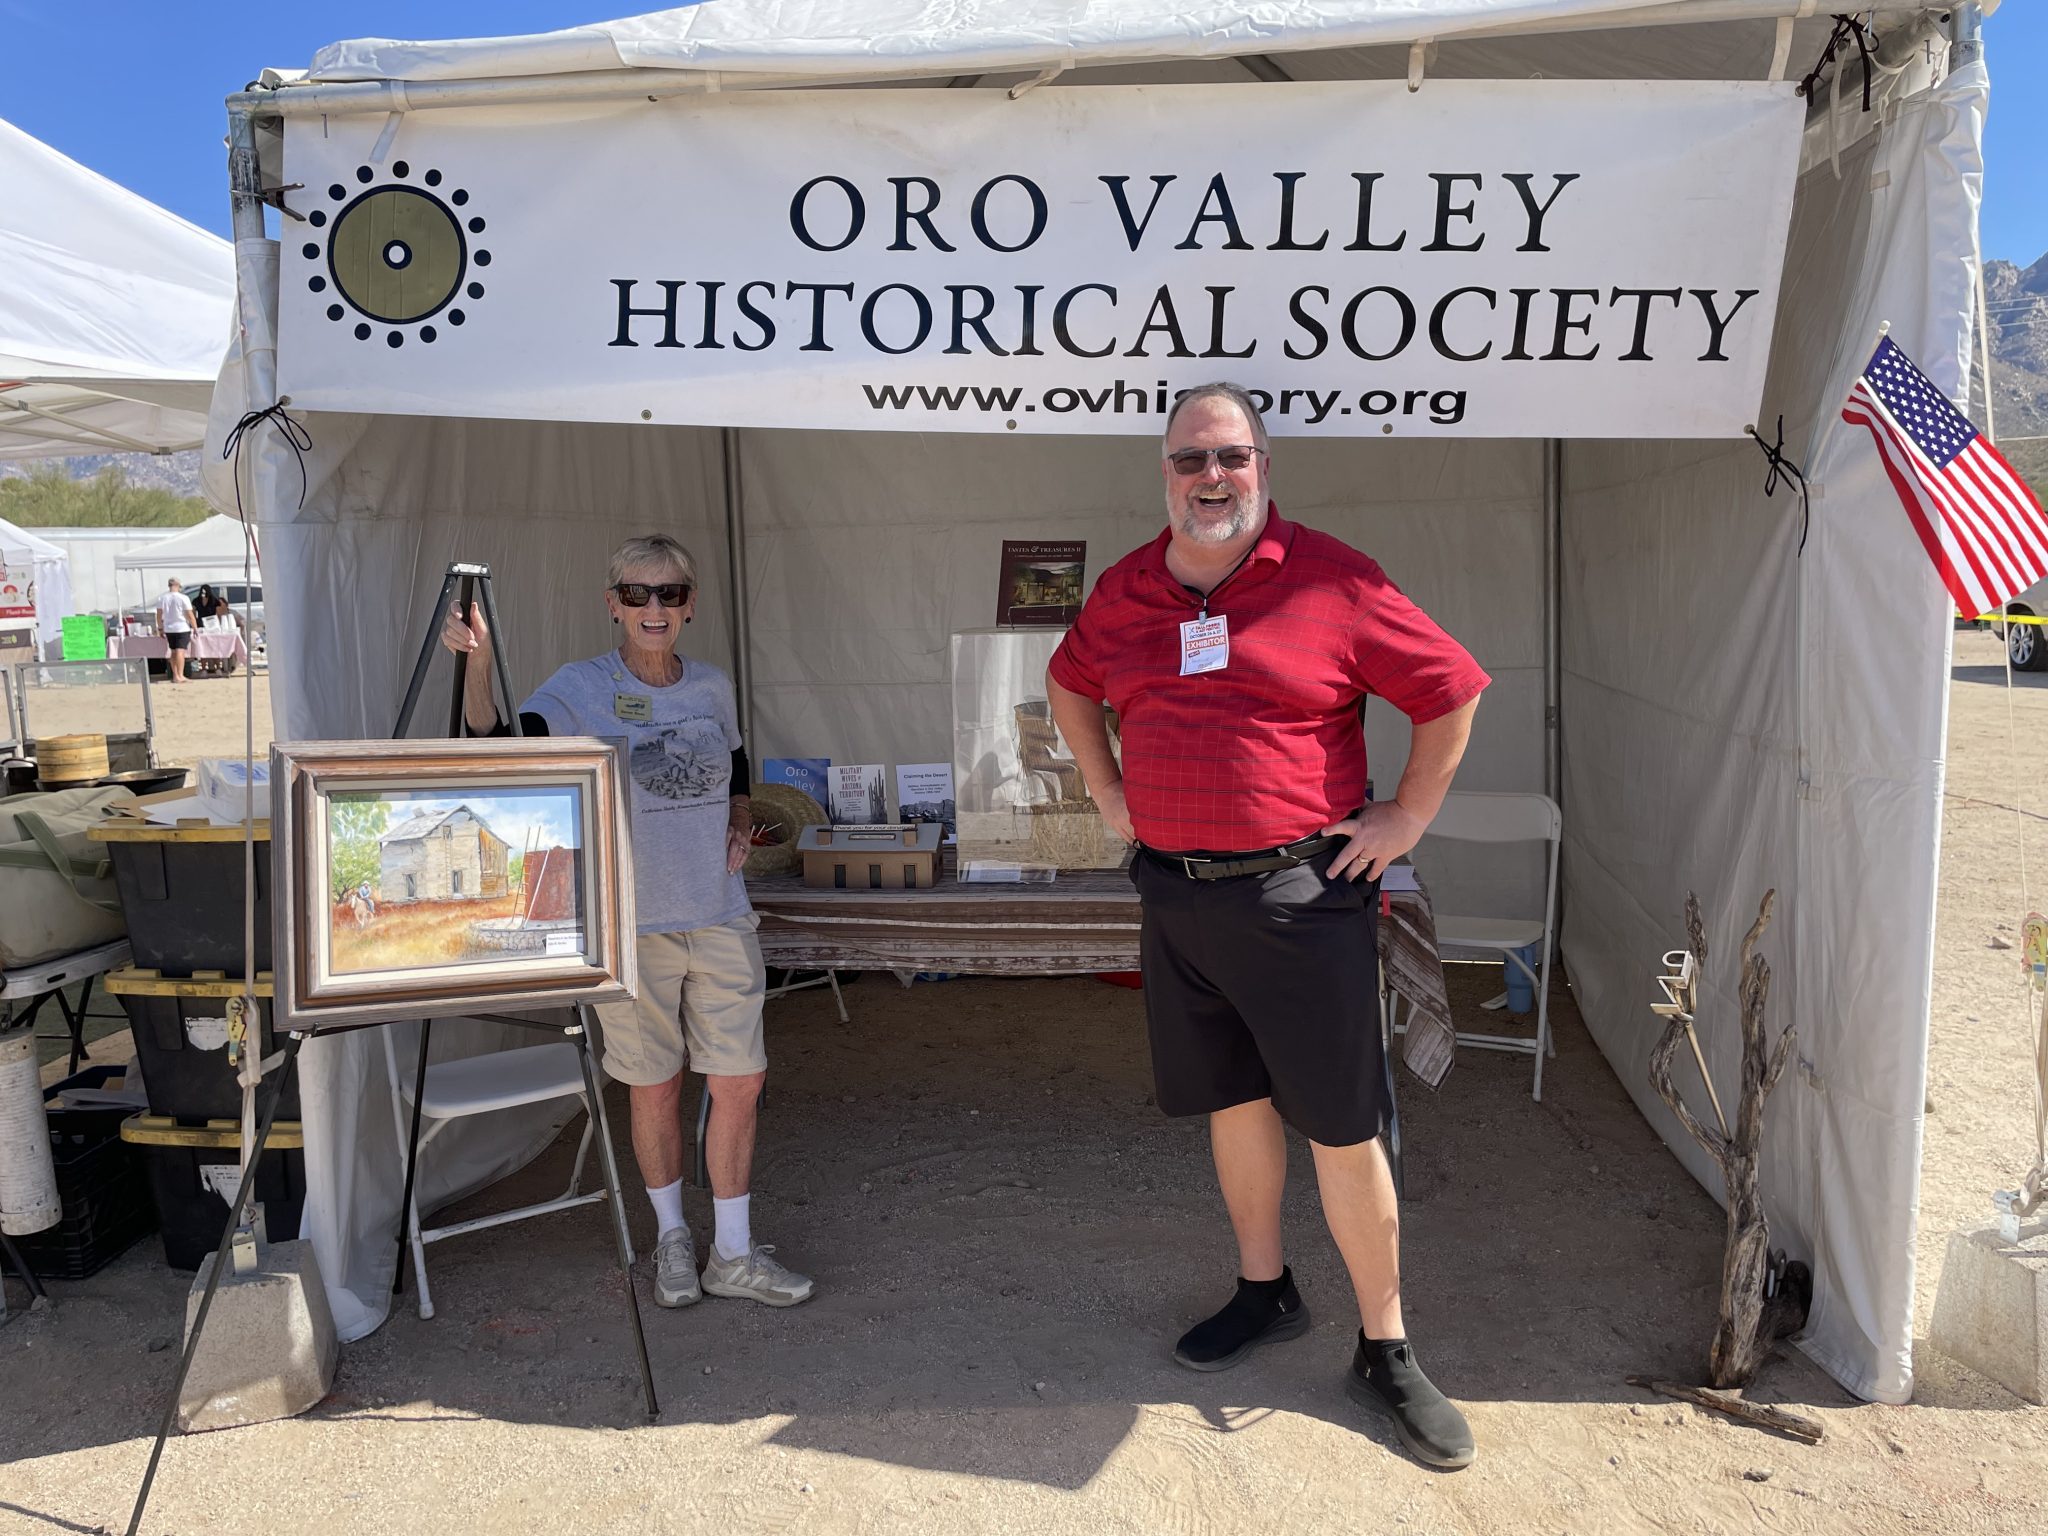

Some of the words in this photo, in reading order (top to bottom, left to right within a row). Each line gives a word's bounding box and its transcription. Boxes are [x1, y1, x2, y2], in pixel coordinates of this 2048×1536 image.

[789, 174, 1049, 252] ORO
[1097, 171, 1581, 252] VALLEY
[607, 278, 1258, 359] HISTORICAL
[1283, 284, 1760, 362] SOCIETY
[861, 379, 1468, 425] www.ovhiory.org
[1186, 636, 1225, 649] EXHIBITOR
[785, 766, 809, 777] Oro
[839, 766, 863, 775] MILITARY
[841, 774, 857, 782] WIVES
[778, 780, 817, 793] lley
[841, 782, 862, 790] ARIZONA
[839, 789, 865, 799] TERRITORY
